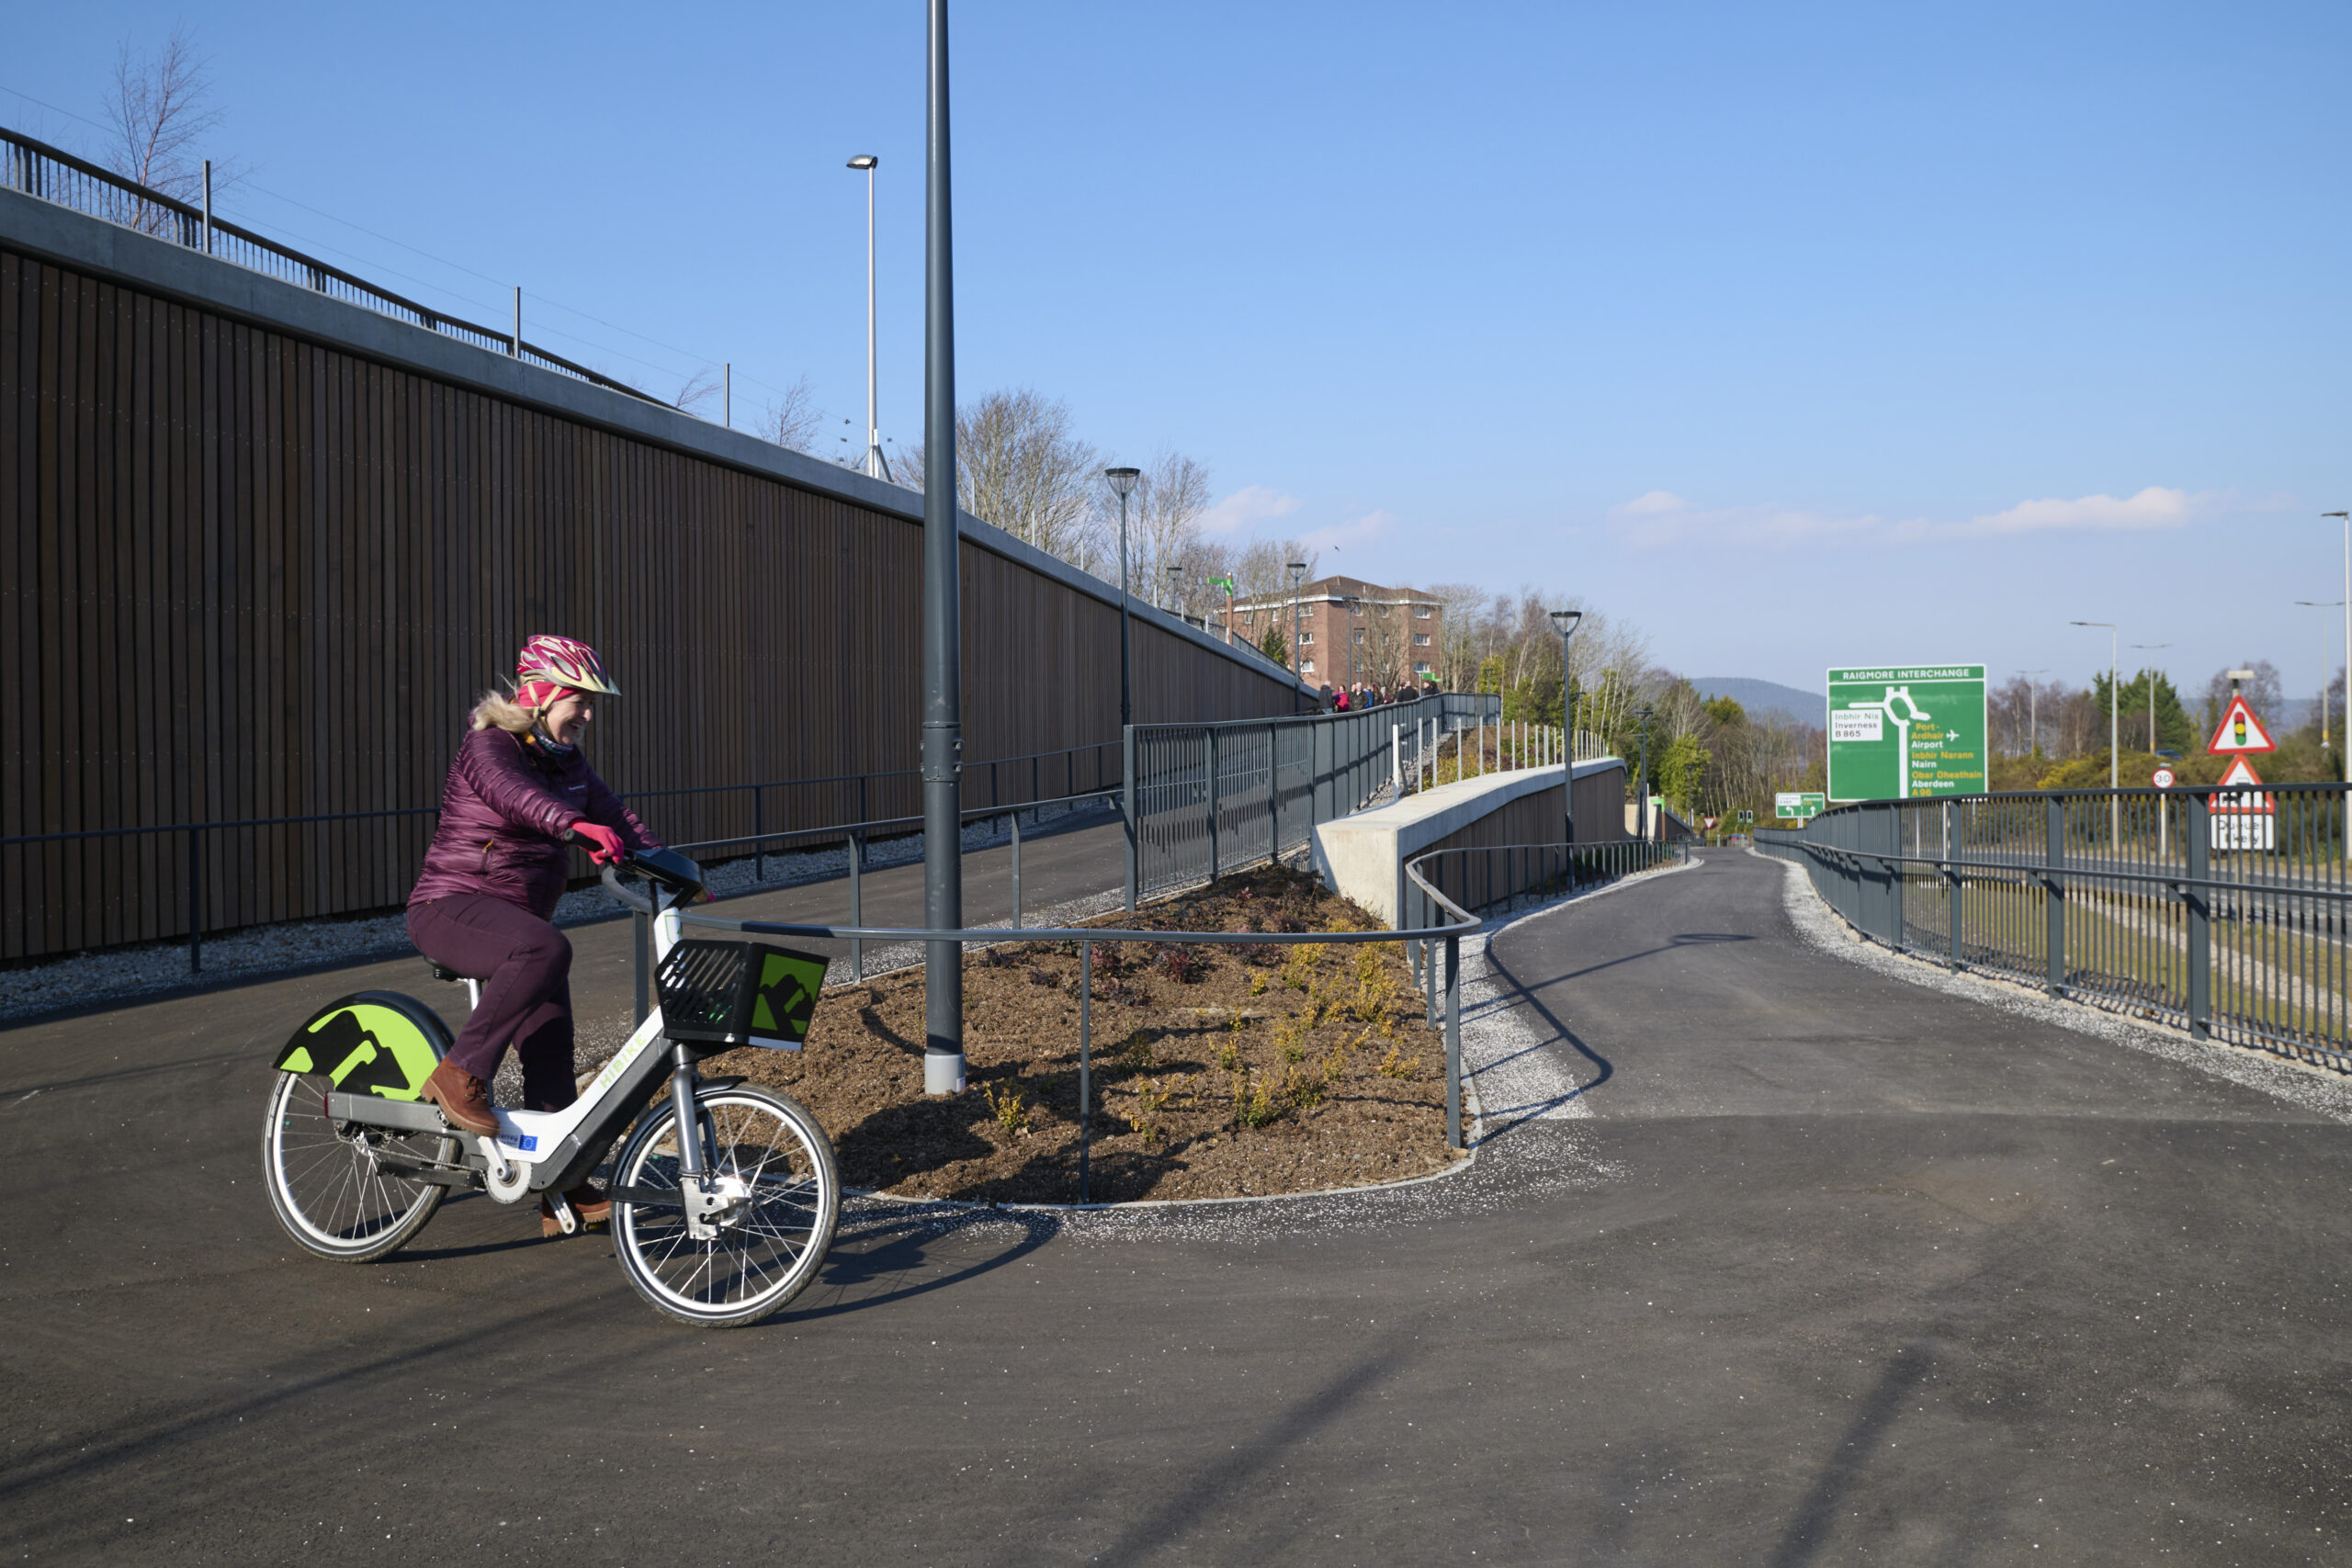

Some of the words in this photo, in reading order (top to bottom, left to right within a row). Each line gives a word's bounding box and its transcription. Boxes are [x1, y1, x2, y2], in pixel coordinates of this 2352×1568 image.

[1842, 671, 1895, 681] RAIGMORE
[1897, 669, 1971, 679] INTERCHANGE
[1911, 740, 1943, 750] Airport
[1911, 751, 1937, 760] Inbhir
[1940, 750, 1974, 759] Narann
[1912, 771, 1934, 779] Obar
[1937, 771, 1983, 779] Dheathain
[2155, 774, 2171, 784] 30
[1912, 780, 1954, 788] Aberdeen
[1912, 788, 1918, 796] A
[1919, 788, 1932, 796] 96
[599, 1032, 648, 1089] HIBIKE
